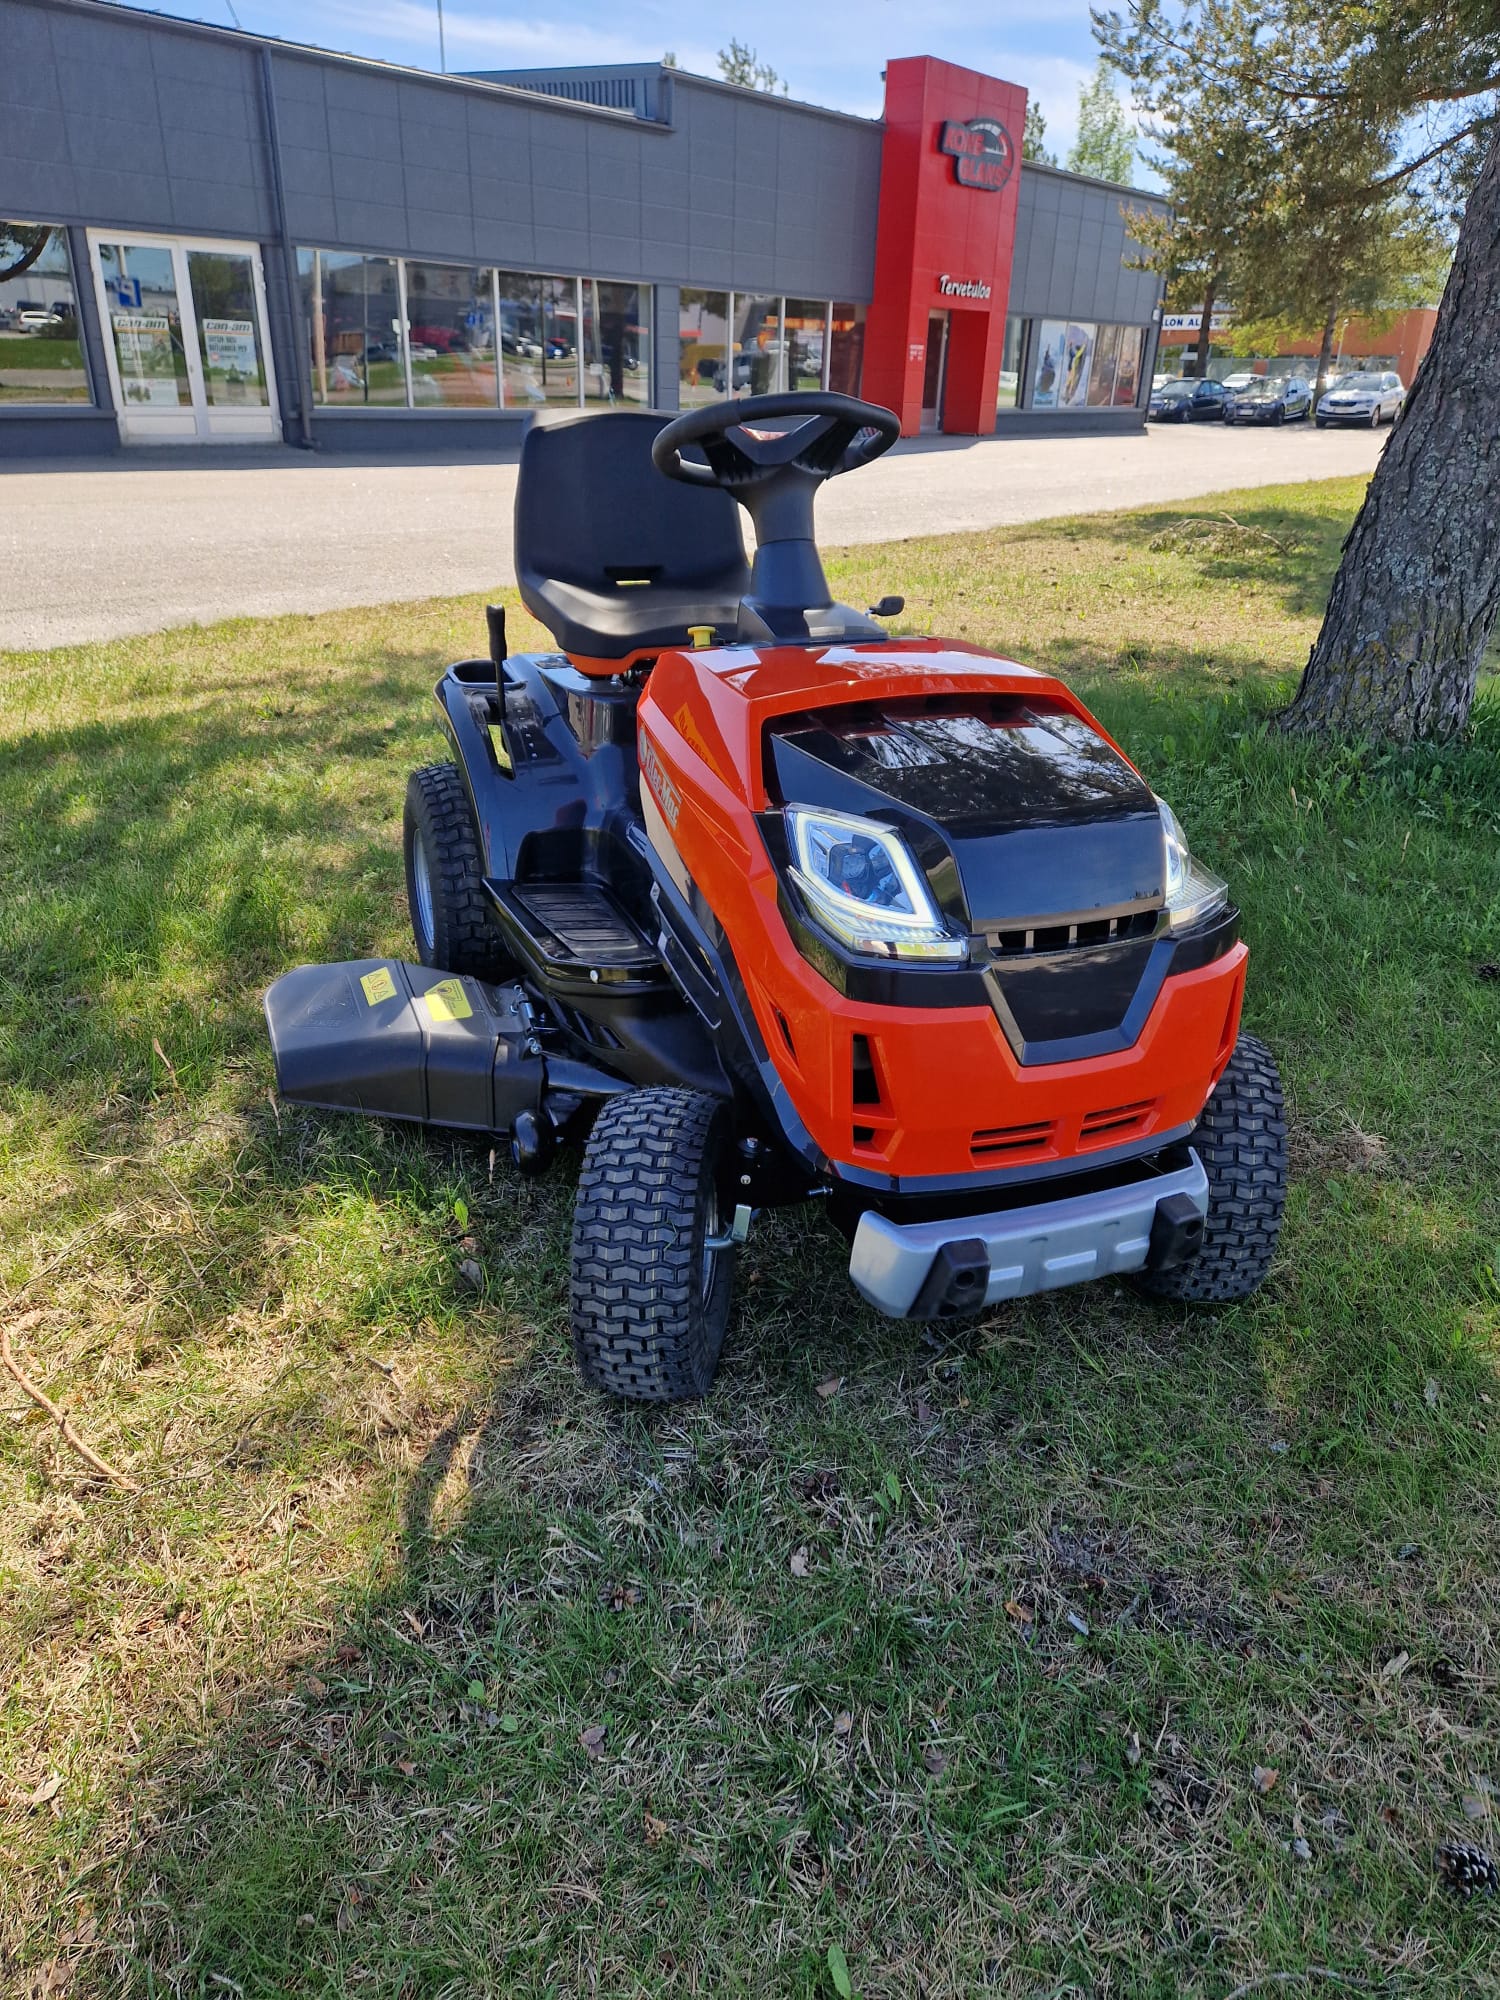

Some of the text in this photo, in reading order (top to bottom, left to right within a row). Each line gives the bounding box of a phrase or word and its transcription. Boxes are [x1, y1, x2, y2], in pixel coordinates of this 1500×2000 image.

[944, 126, 985, 157] KONE
[940, 274, 991, 299] Tervetuloa
[117, 319, 166, 329] can-am
[206, 322, 250, 332] can-am
